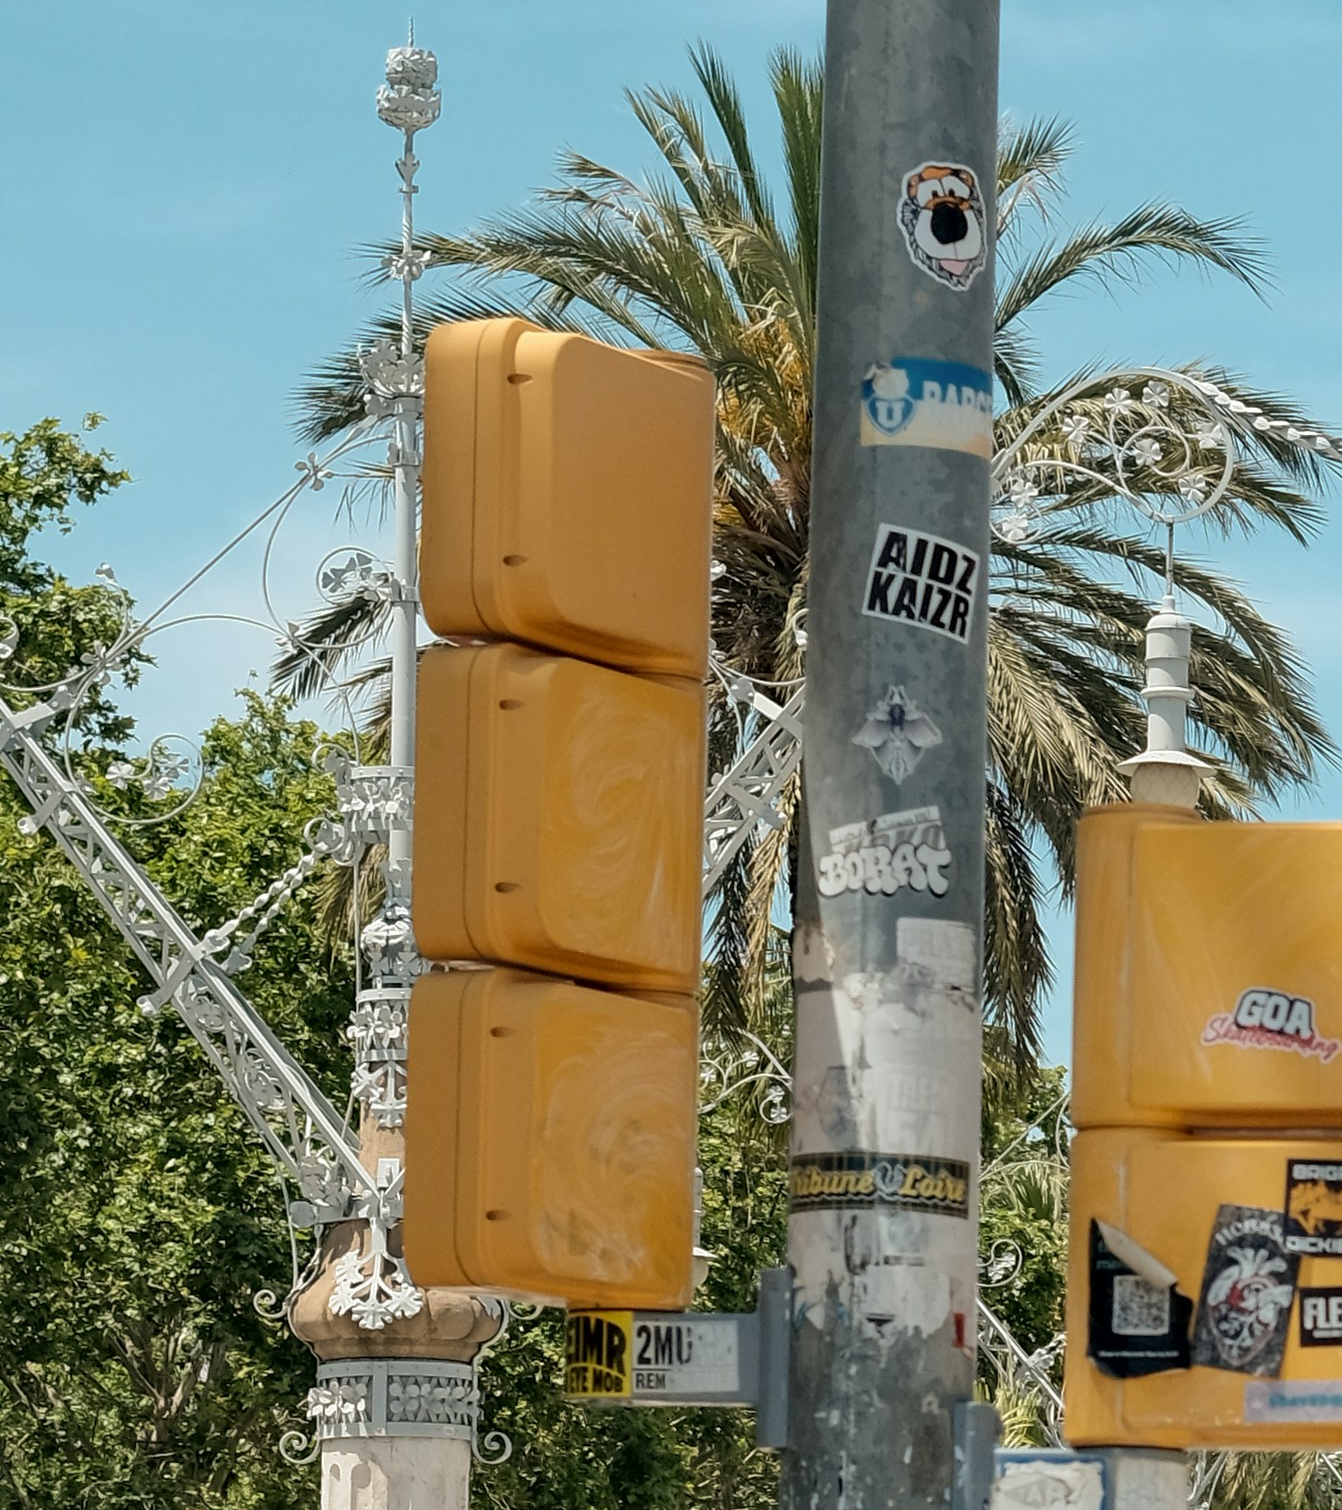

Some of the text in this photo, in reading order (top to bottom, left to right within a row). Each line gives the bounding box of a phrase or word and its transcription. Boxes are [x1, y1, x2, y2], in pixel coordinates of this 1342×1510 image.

[877, 531, 976, 596] AIDZ
[868, 571, 970, 639] KAIZR
[818, 843, 952, 898] BORAT
[1236, 990, 1313, 1040] GOA
[635, 1372, 666, 1389] REM
